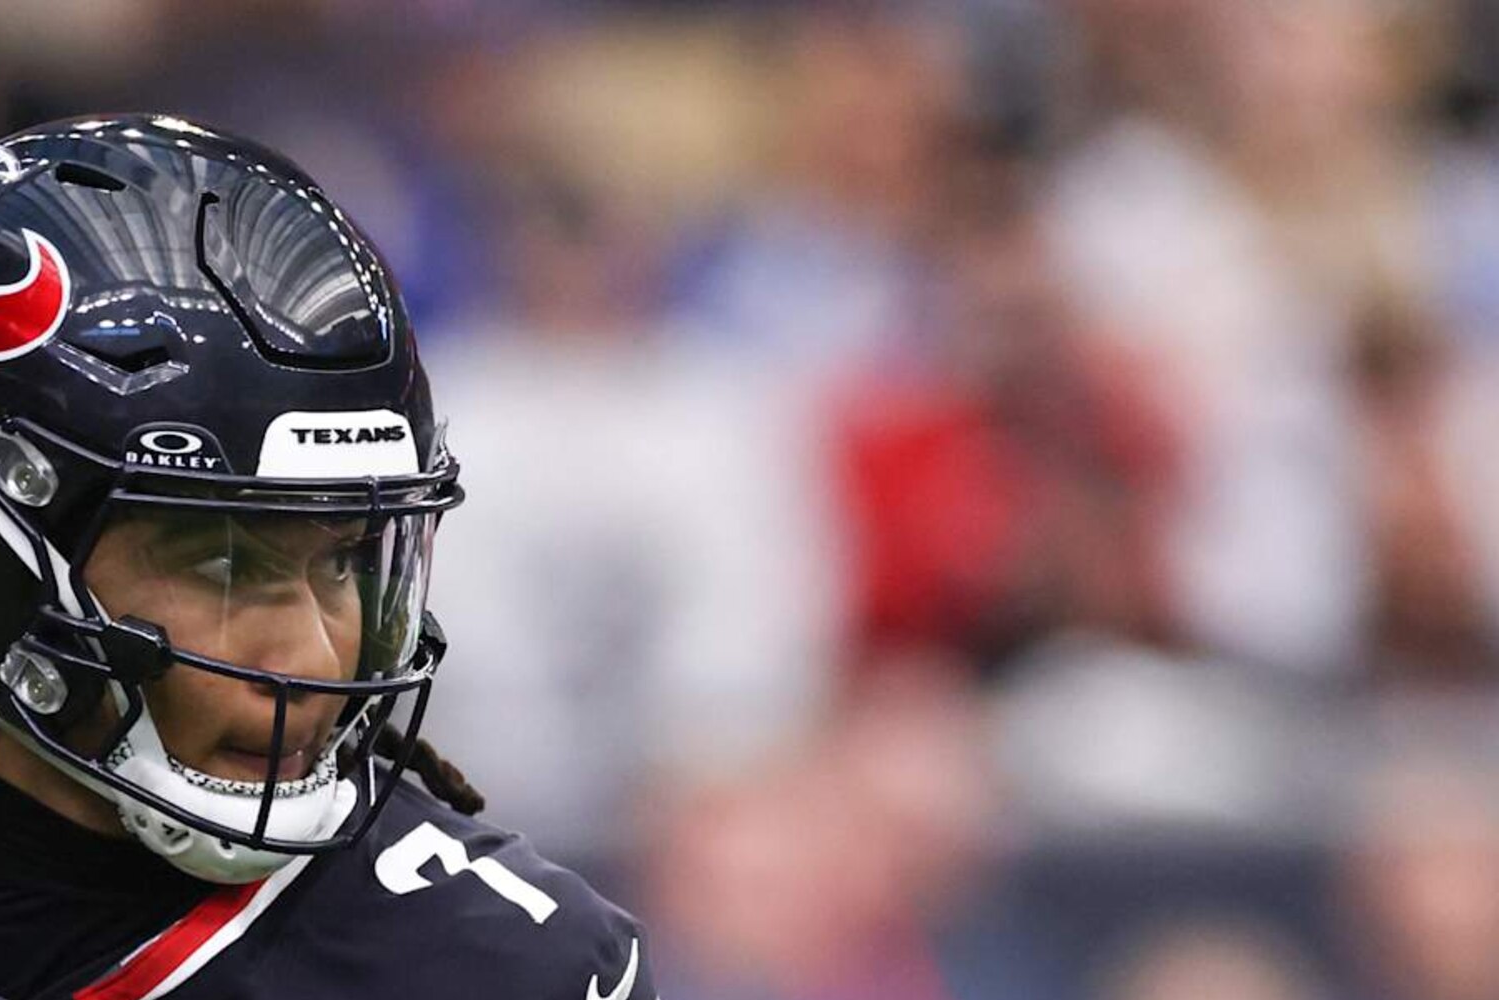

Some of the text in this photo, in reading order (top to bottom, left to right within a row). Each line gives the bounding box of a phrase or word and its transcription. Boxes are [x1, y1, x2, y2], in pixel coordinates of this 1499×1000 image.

[290, 425, 406, 445] TEXANS
[125, 451, 219, 469] OAKLEY
[374, 820, 559, 924] 7
